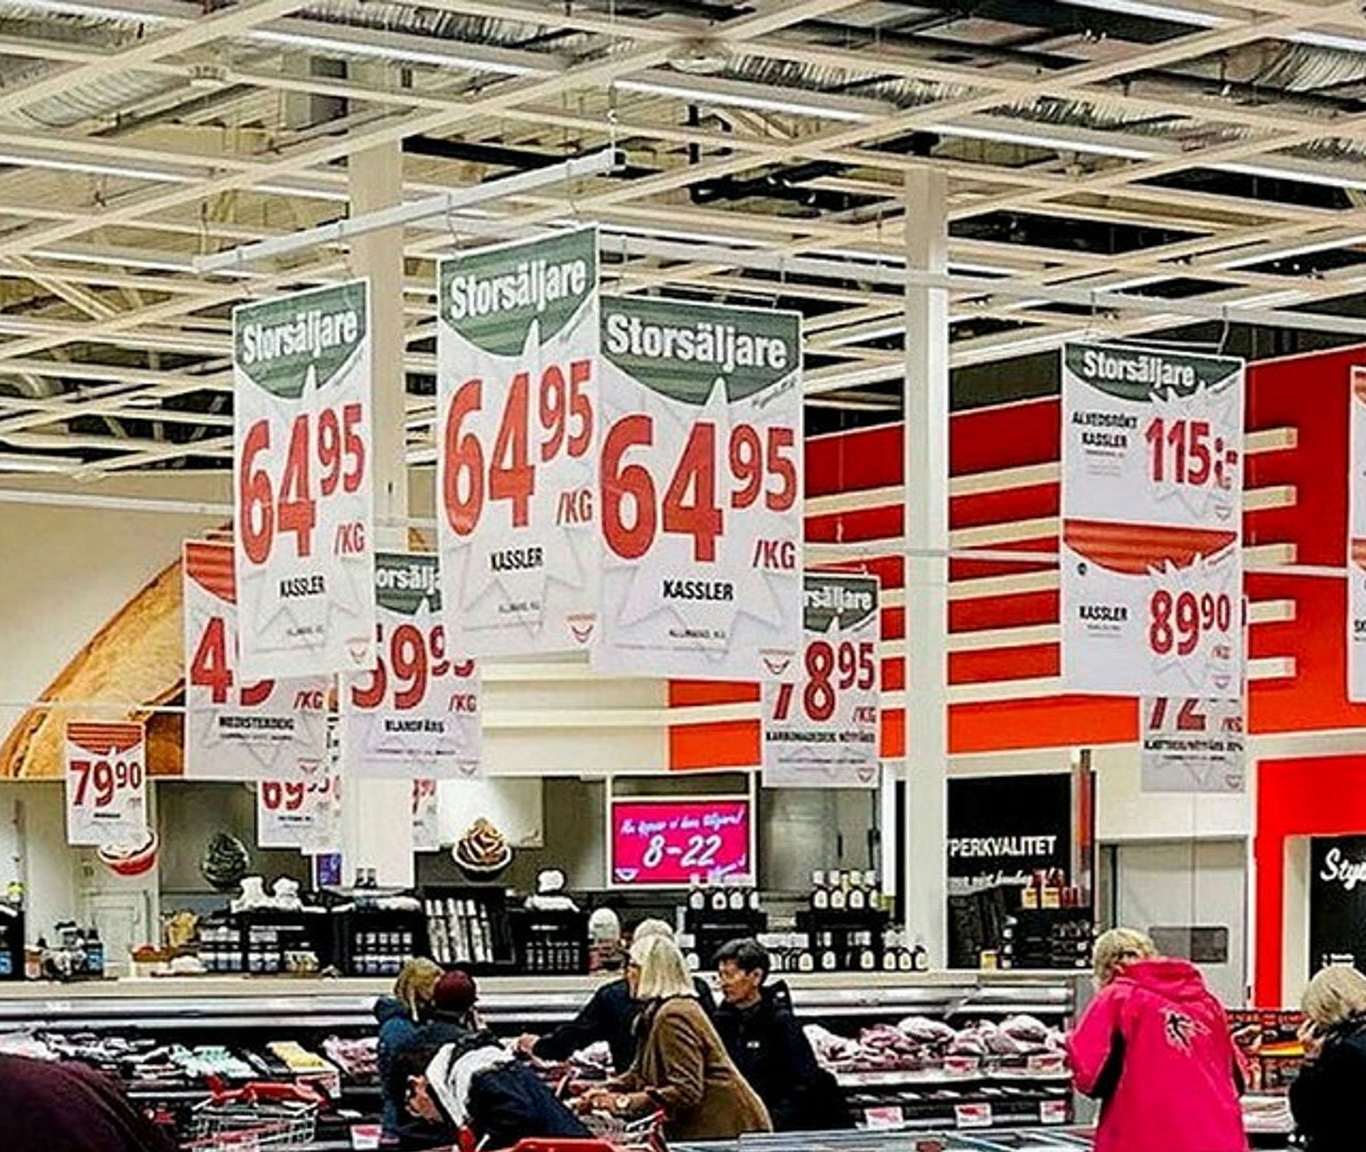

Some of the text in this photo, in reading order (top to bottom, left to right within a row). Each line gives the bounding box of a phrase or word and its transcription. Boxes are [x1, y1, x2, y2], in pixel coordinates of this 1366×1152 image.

[450, 258, 586, 319] Storsäljare
[242, 312, 358, 364] Storsäljare
[606, 315, 787, 372] Storsäljare
[1084, 351, 1195, 388] Storsäljare
[556, 490, 592, 524] /KG
[334, 523, 365, 555] /KG
[752, 539, 796, 570] /KG
[490, 547, 543, 572] KASSLER
[280, 575, 326, 599] KASSLER
[663, 580, 734, 600] KASSLER
[643, 834, 722, 868] 8-22
